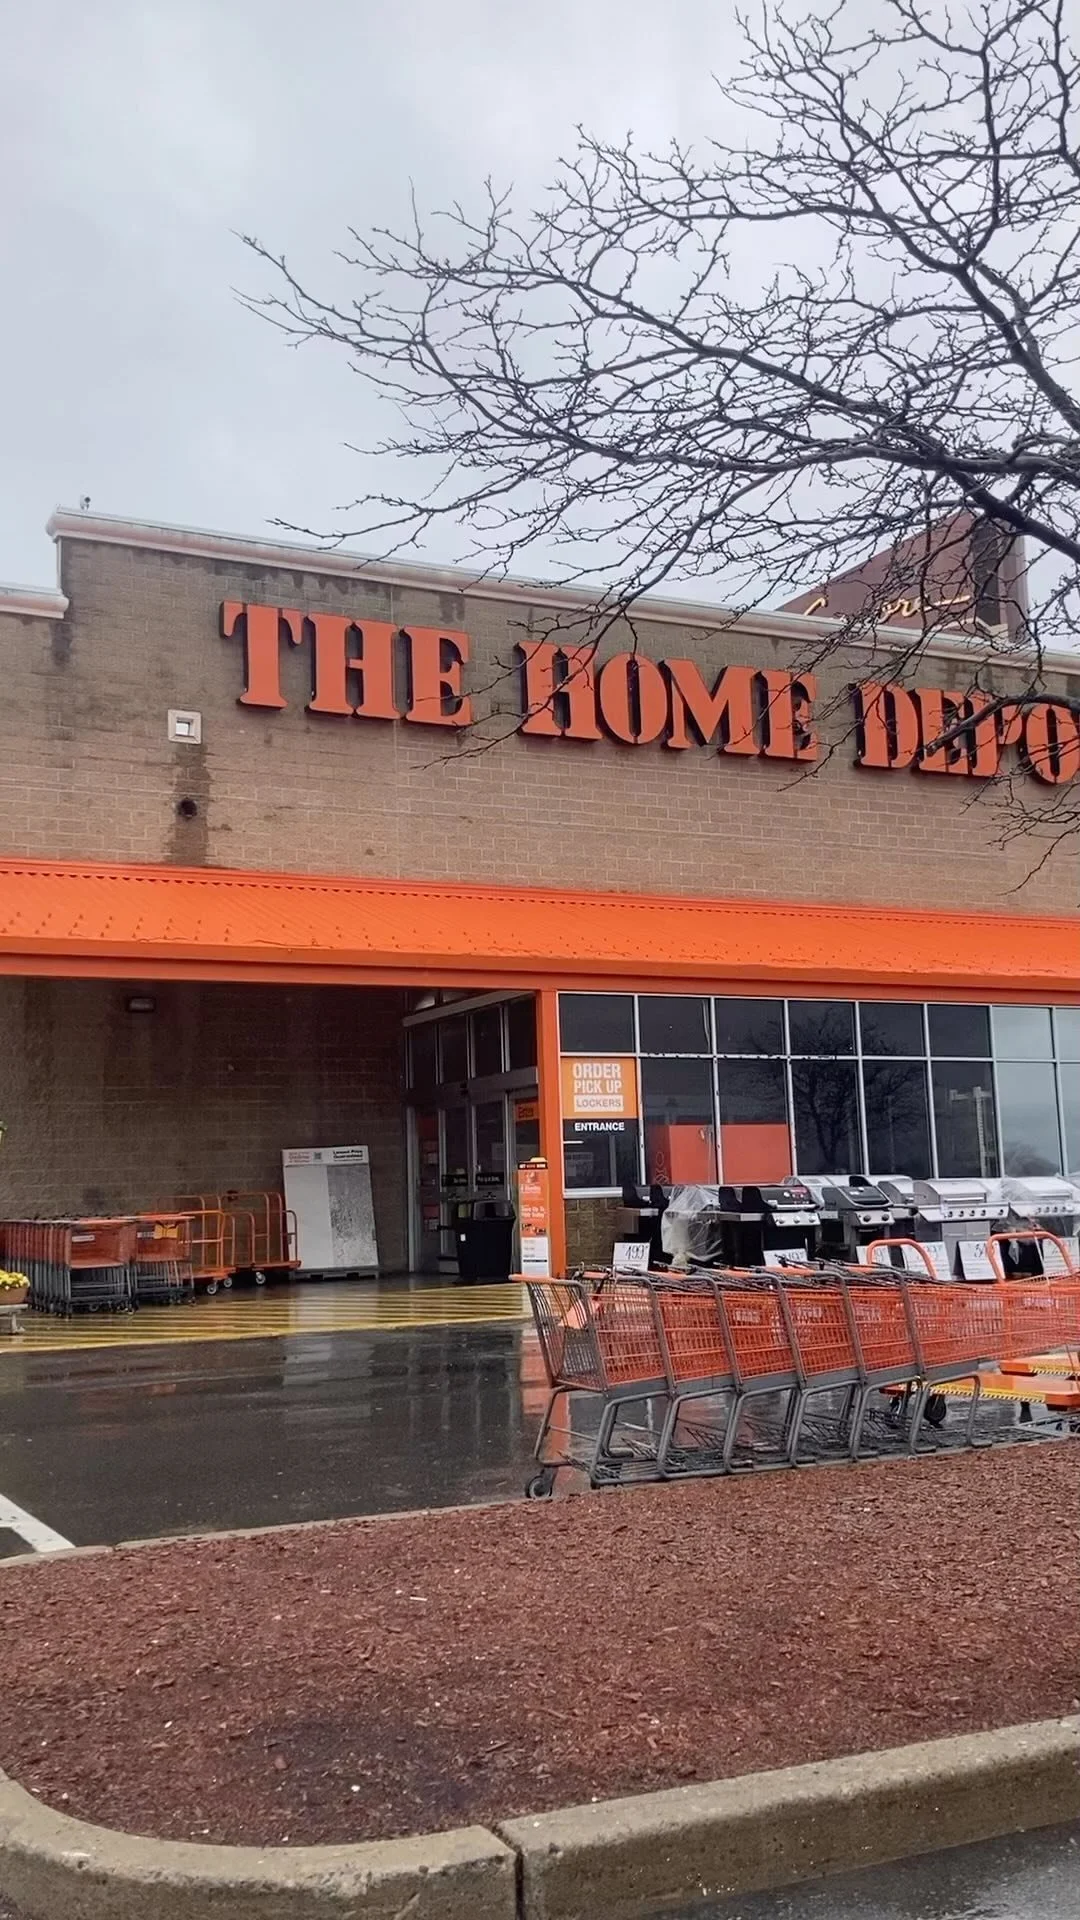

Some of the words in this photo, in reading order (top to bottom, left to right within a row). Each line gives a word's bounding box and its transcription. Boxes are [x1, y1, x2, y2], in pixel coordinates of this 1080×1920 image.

[221, 601, 473, 727] THE
[518, 640, 818, 762] HOME
[573, 1063, 621, 1079] ORDER
[574, 1080, 602, 1094] PICK
[606, 1080, 622, 1094] UP
[576, 1098, 622, 1108] LOCKERS
[574, 1122, 626, 1132] ENTRANCE
